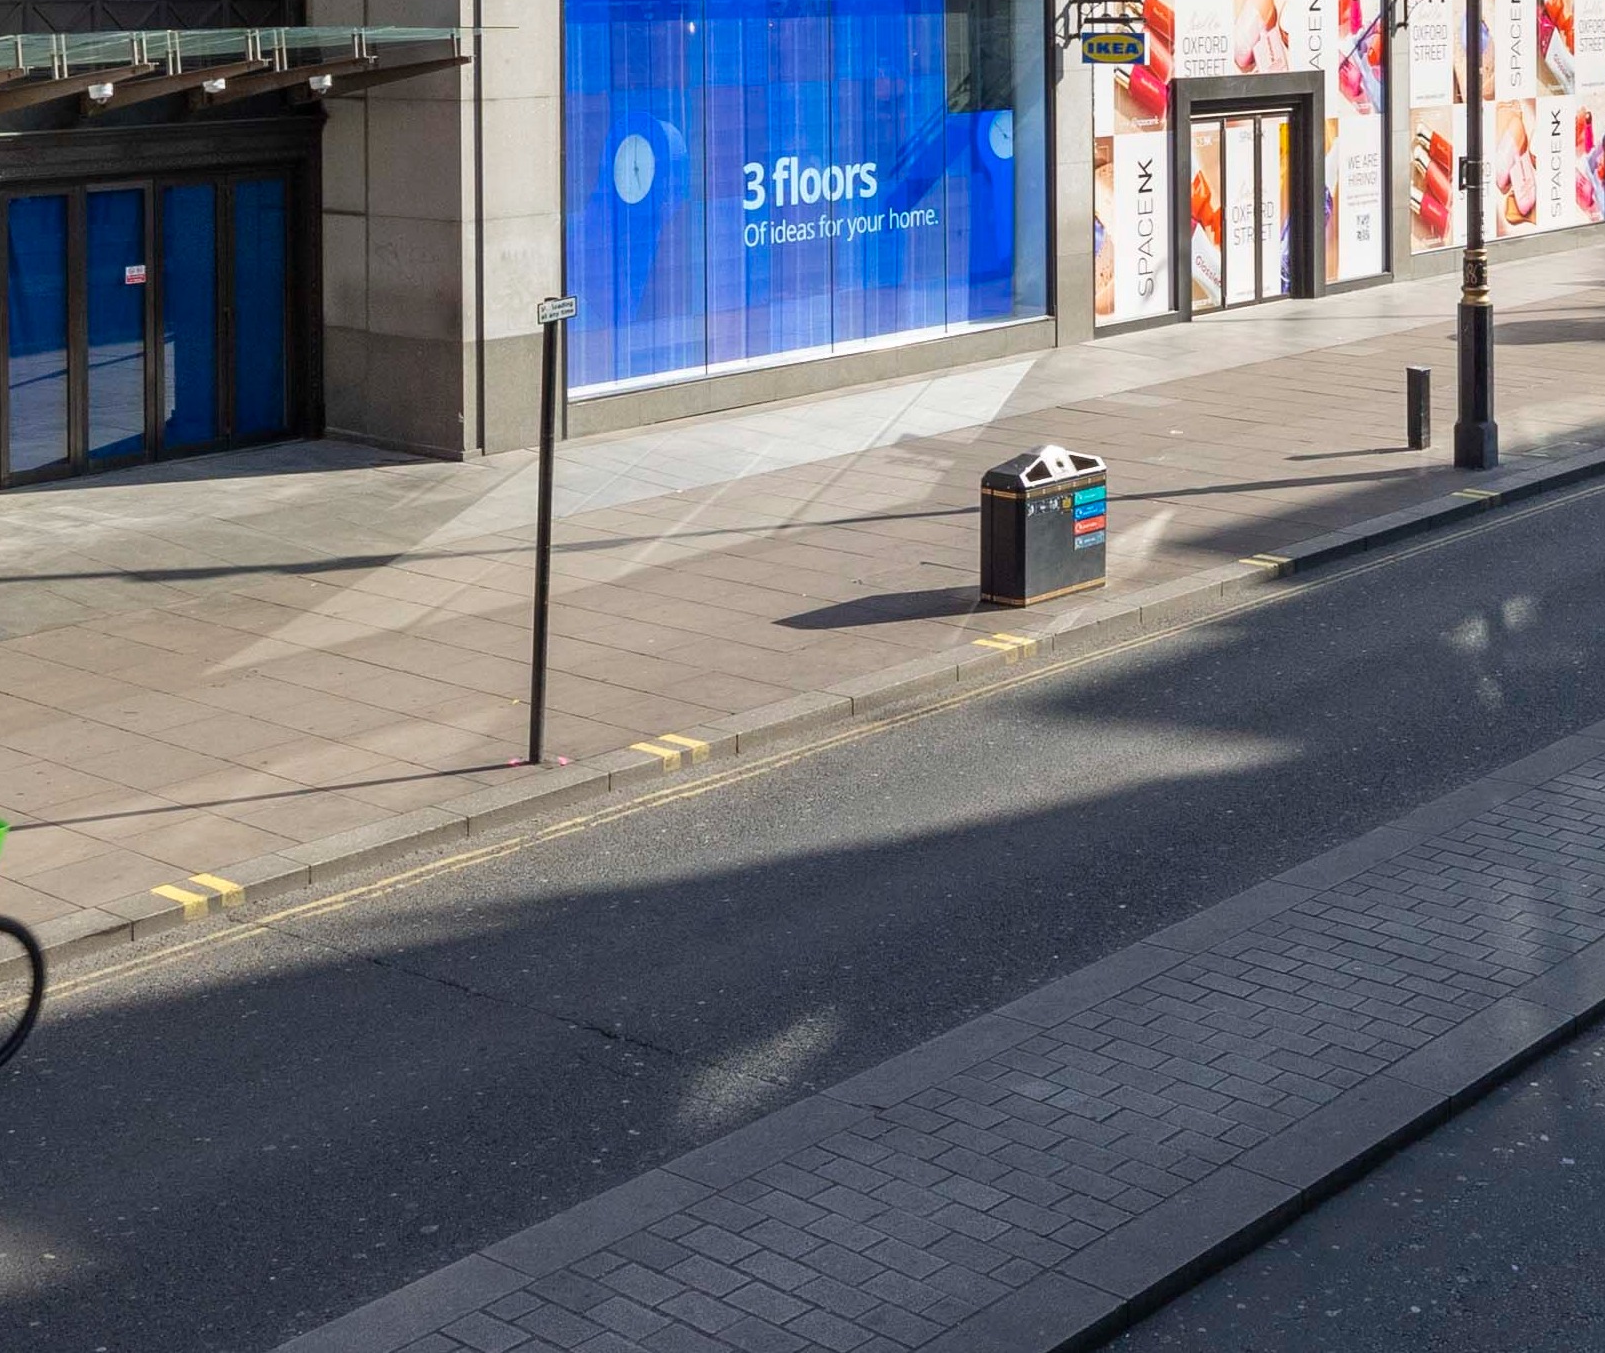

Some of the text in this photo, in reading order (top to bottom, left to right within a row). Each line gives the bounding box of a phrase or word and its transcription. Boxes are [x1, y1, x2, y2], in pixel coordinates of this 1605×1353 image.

[1413, 24, 1447, 41] OXFORD
[1088, 42, 1140, 55] IKEA
[1182, 35, 1228, 55] OXFORD
[1414, 44, 1447, 61] STREET
[1184, 58, 1228, 77] STREET
[1348, 152, 1379, 169] WE ARE
[742, 160, 878, 210] 3 floors
[1231, 201, 1275, 225] OXFRD
[743, 205, 940, 250] Of ideas for your home.
[1233, 227, 1274, 246] STRET
